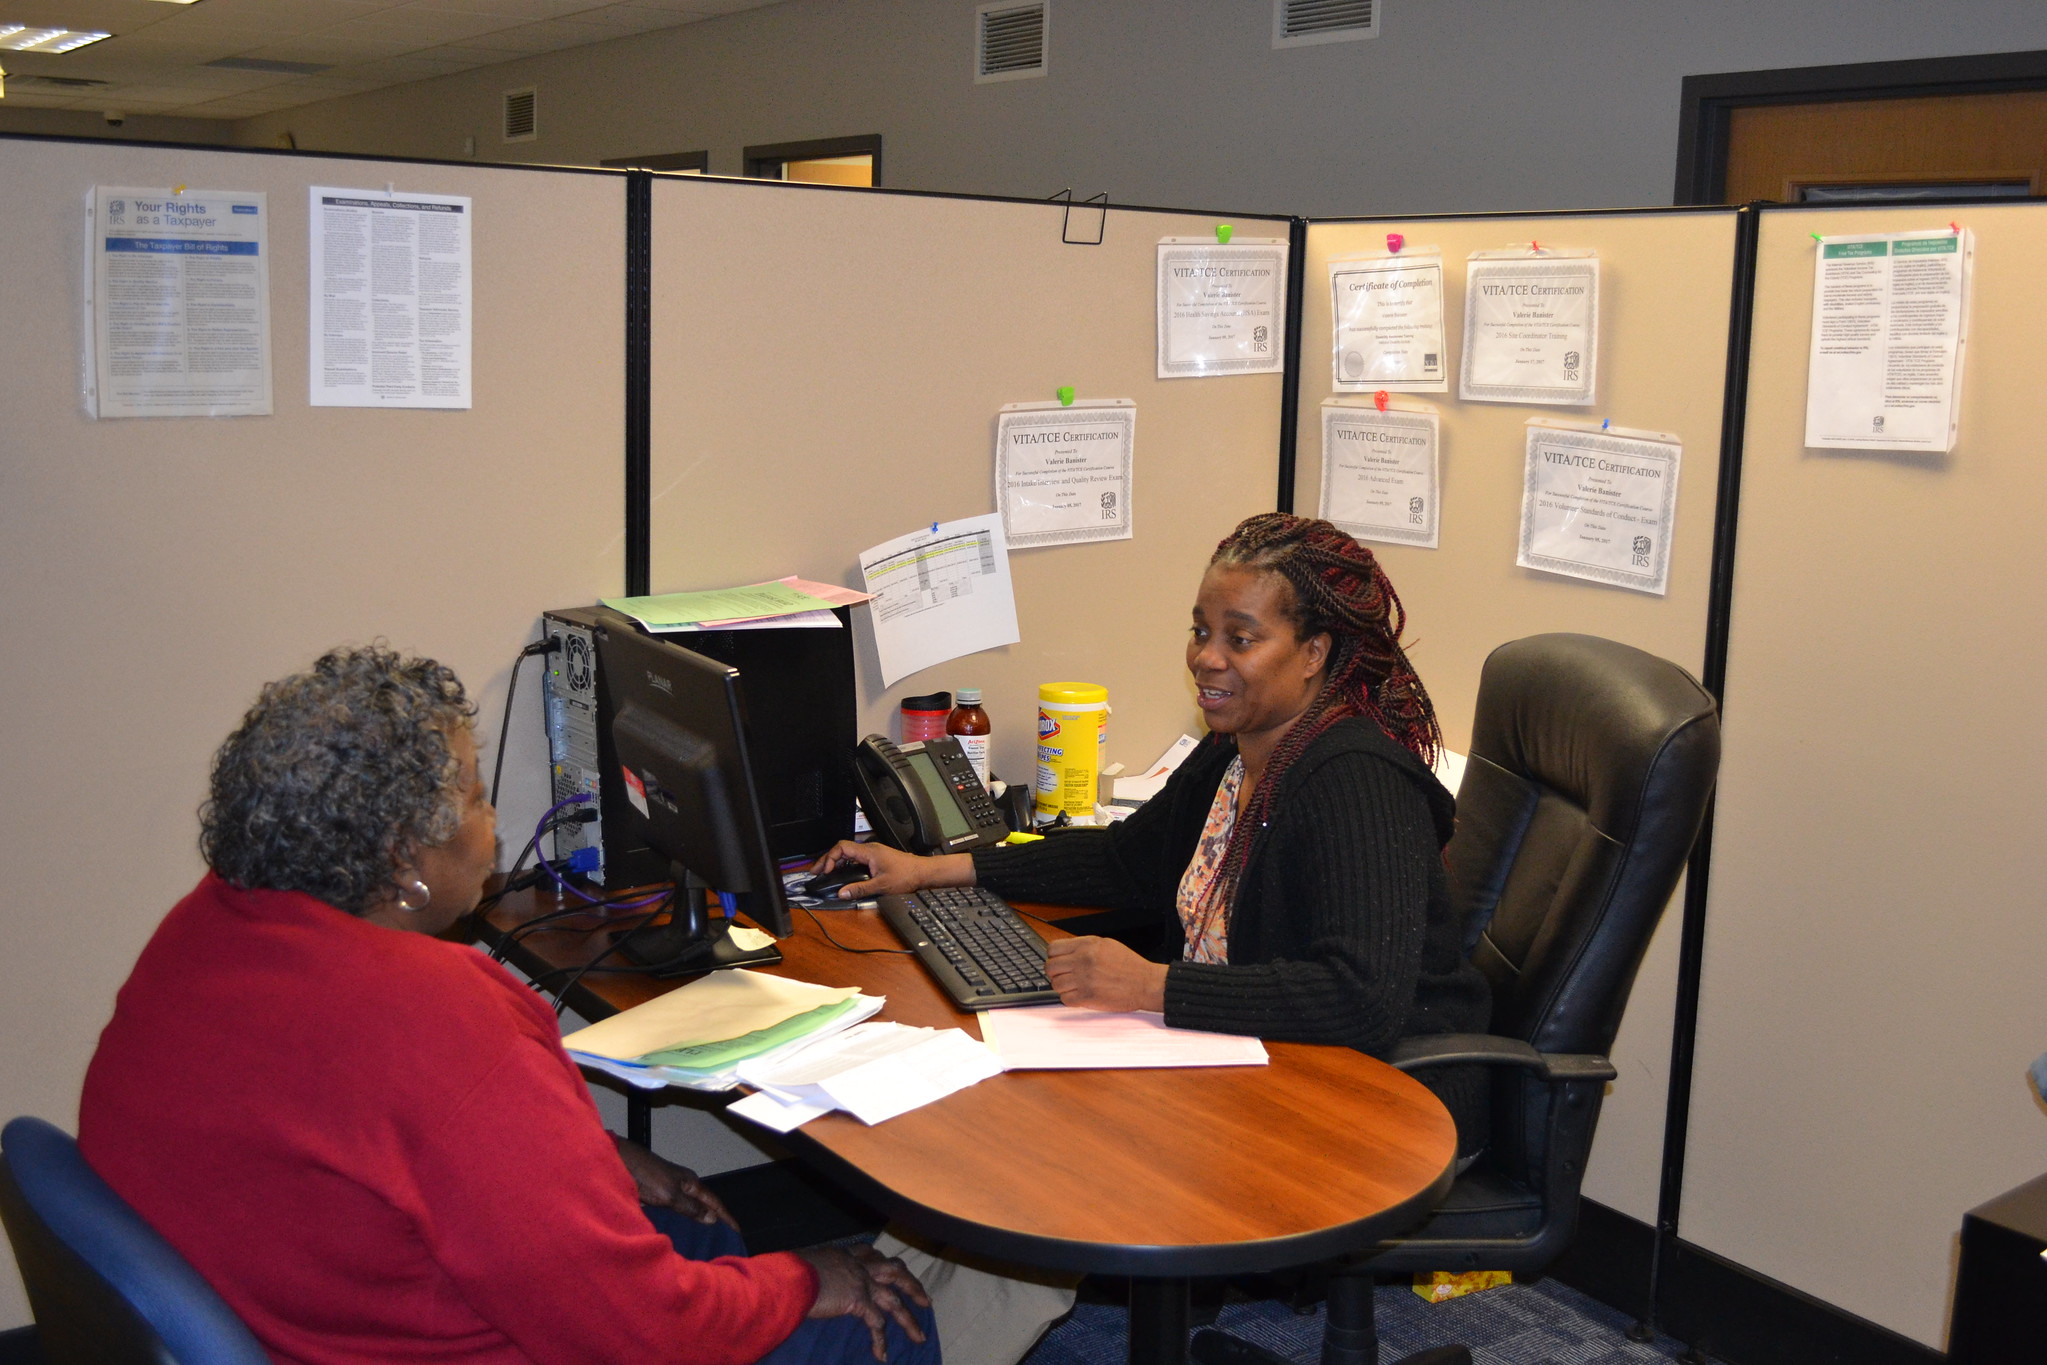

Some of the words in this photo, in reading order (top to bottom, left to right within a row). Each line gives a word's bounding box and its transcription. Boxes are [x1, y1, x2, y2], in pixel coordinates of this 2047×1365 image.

[135, 201, 162, 213] Your
[166, 202, 206, 216] Rights
[110, 216, 125, 225] IRS
[136, 216, 150, 224] as
[153, 216, 160, 225] a
[164, 215, 217, 229] Taxpayer
[135, 242, 148, 250] The
[150, 242, 182, 252] Taxpayer
[206, 244, 228, 252] Rights
[1174, 267, 1217, 278] VITATCE
[1349, 282, 1388, 292] Certificate
[1390, 280, 1398, 290] of
[1398, 278, 1433, 290] Completion
[1482, 285, 1528, 296] VITA/TCE
[1518, 332, 1548, 340] Coordinator
[1548, 332, 1568, 341] Training
[1254, 342, 1268, 352] IRS
[1563, 370, 1579, 381] IRS
[1013, 432, 1060, 445] VITA/TCE
[1337, 430, 1378, 442] VITA/TCE
[1045, 458, 1064, 466] Valerie
[1364, 456, 1380, 464] Valerie
[1380, 457, 1400, 465] Banister
[1544, 452, 1596, 469] VITA/TCE
[1008, 480, 1020, 488] 2016
[1021, 480, 1037, 488] Intake
[1062, 477, 1071, 485] and
[1072, 476, 1089, 485] Quality
[1370, 476, 1390, 484] Advanced
[1577, 484, 1597, 494] Valerie
[1598, 488, 1622, 498] Banister
[1101, 509, 1117, 520] IRS
[1408, 513, 1424, 524] IRS
[1539, 500, 1554, 508] 2016
[1580, 506, 1606, 518] Standards
[1606, 510, 1613, 518] of
[1612, 512, 1636, 522] Conduct
[1640, 516, 1658, 526] Exam
[1632, 554, 1650, 568] IRS
